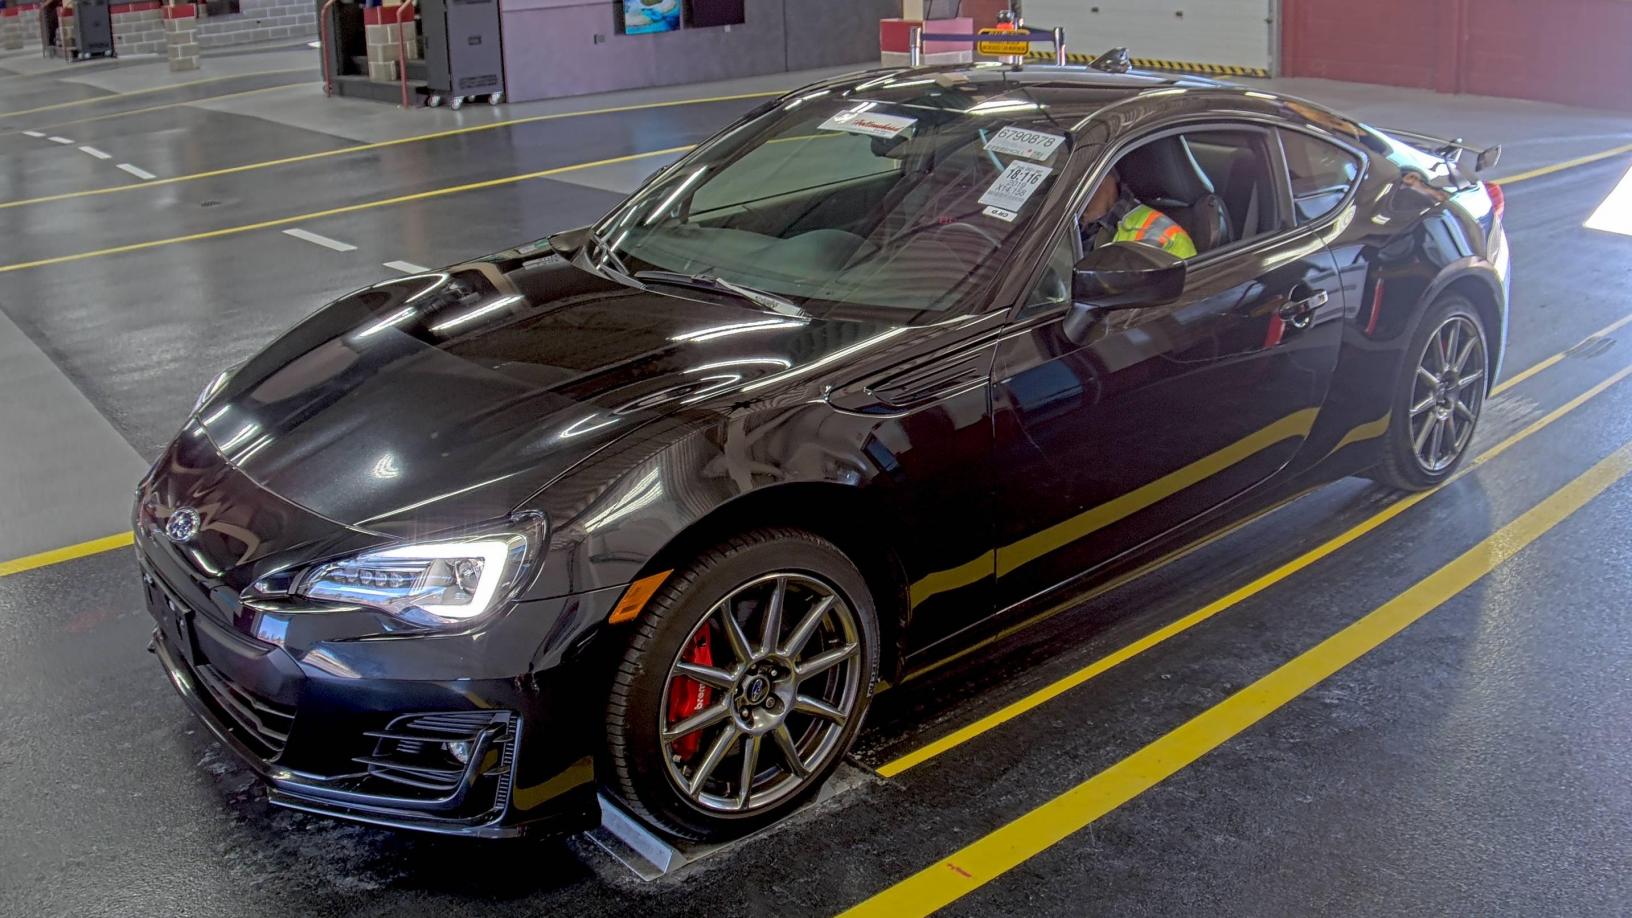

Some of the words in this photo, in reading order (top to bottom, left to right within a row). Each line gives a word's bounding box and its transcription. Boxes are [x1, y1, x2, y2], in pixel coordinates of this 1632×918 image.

[1000, 129, 1056, 148] 6790878
[1006, 168, 1042, 185] 18:116
[694, 683, 706, 710] brem
